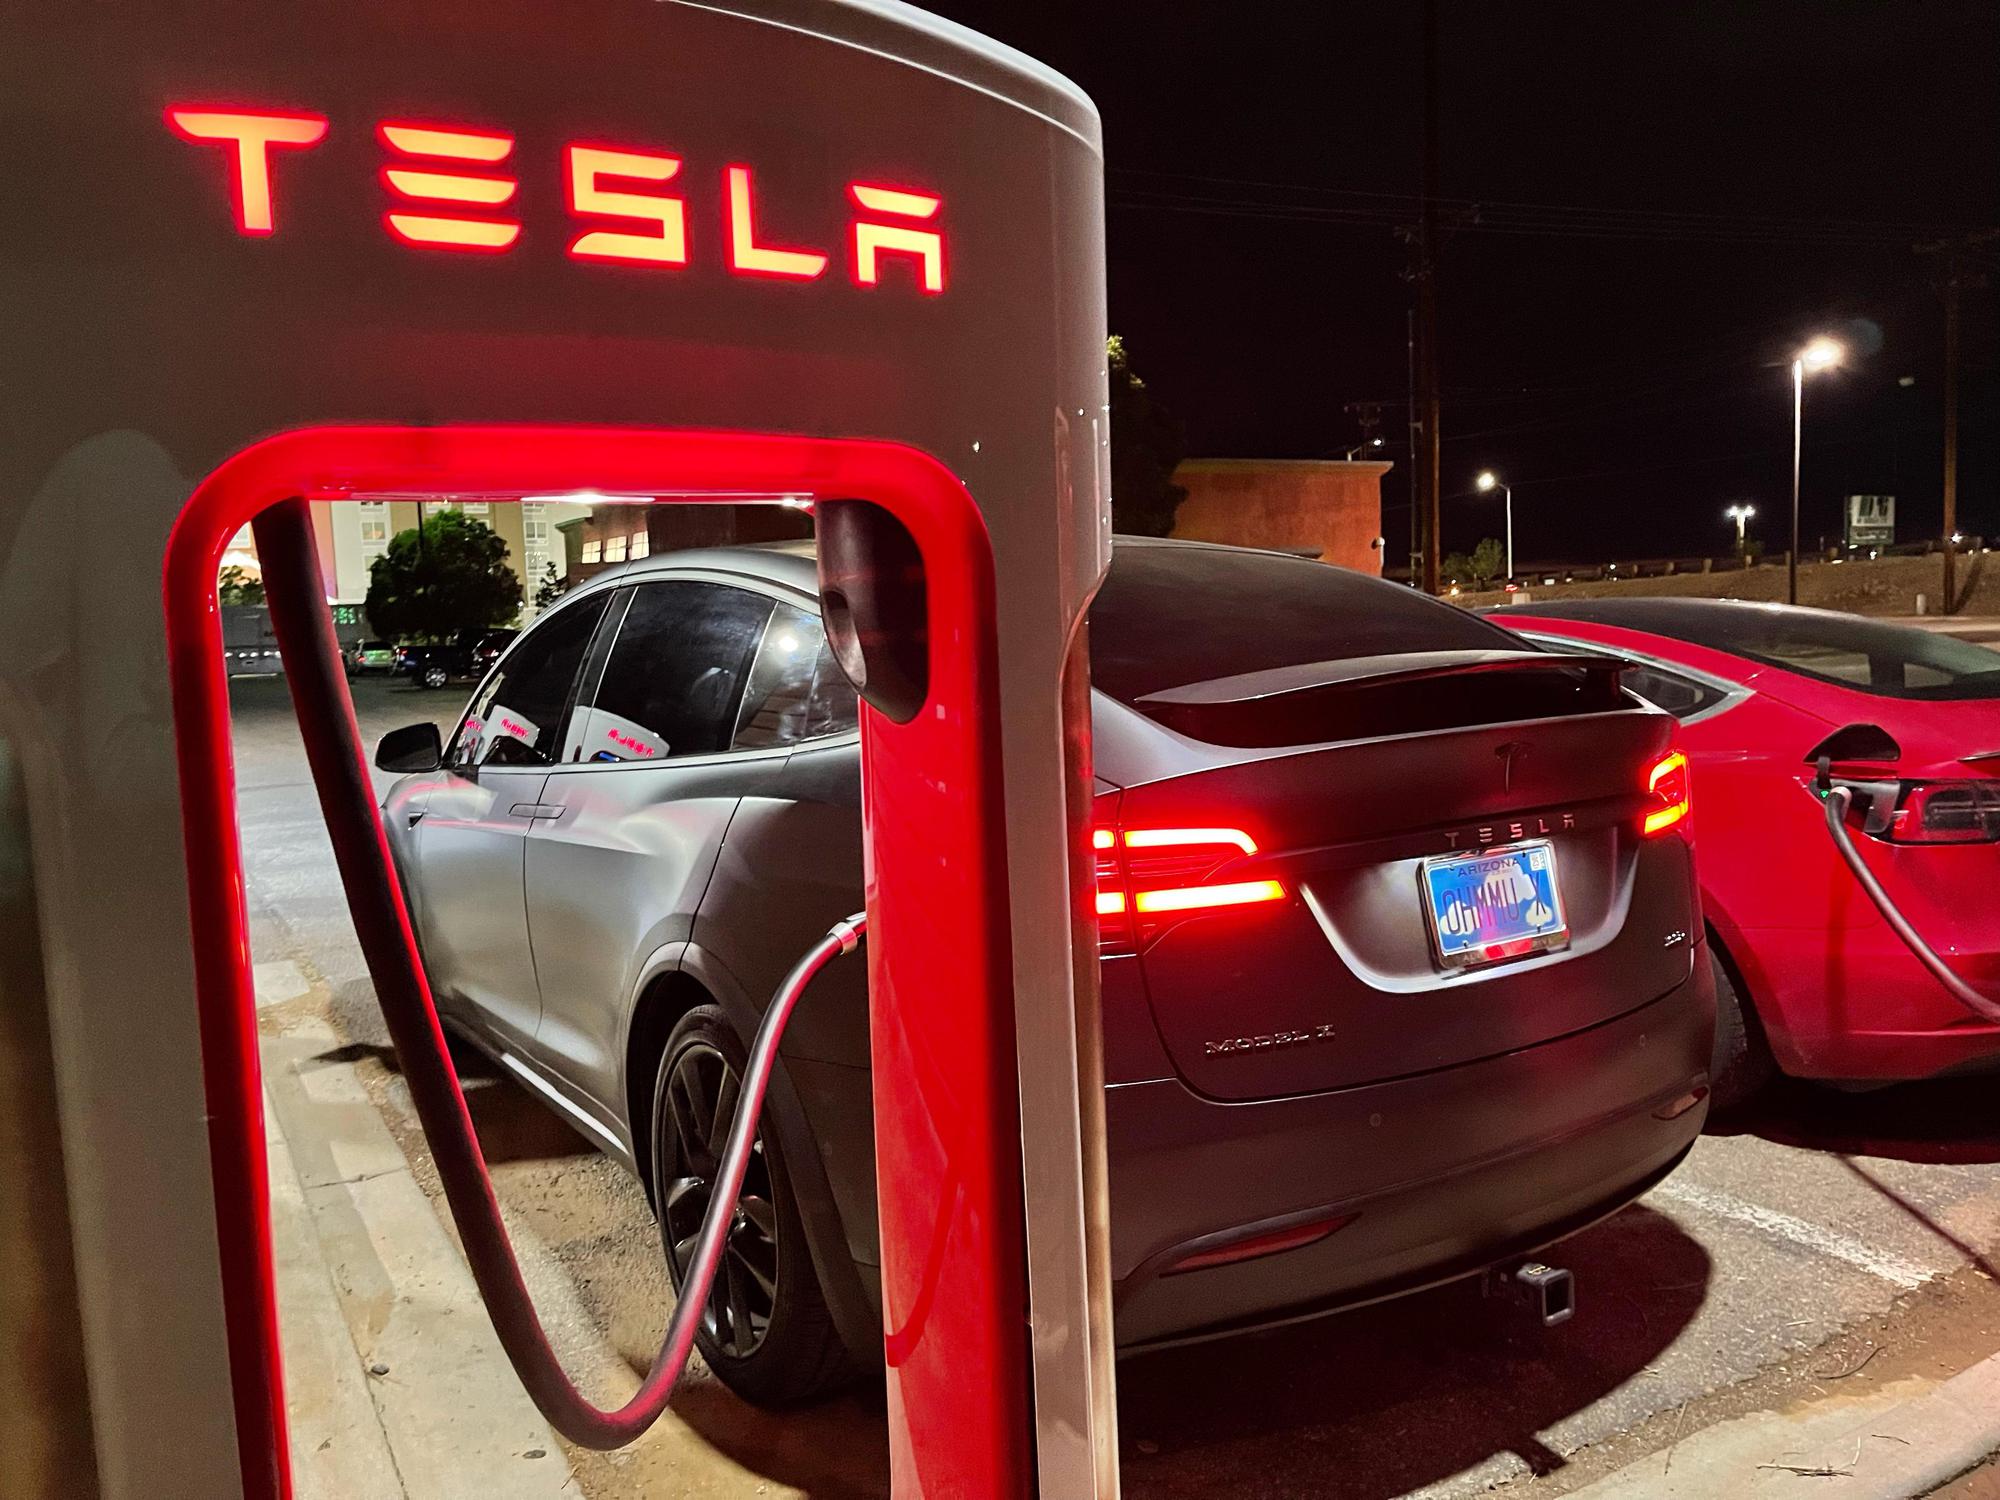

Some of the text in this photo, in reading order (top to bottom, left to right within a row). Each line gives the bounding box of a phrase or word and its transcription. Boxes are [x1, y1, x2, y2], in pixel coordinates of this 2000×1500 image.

[166, 107, 945, 294] TESLA
[1445, 814, 1574, 847] TESLA
[1457, 857, 1520, 877] ARIZONA
[1205, 1030, 1310, 1054] MODEL
